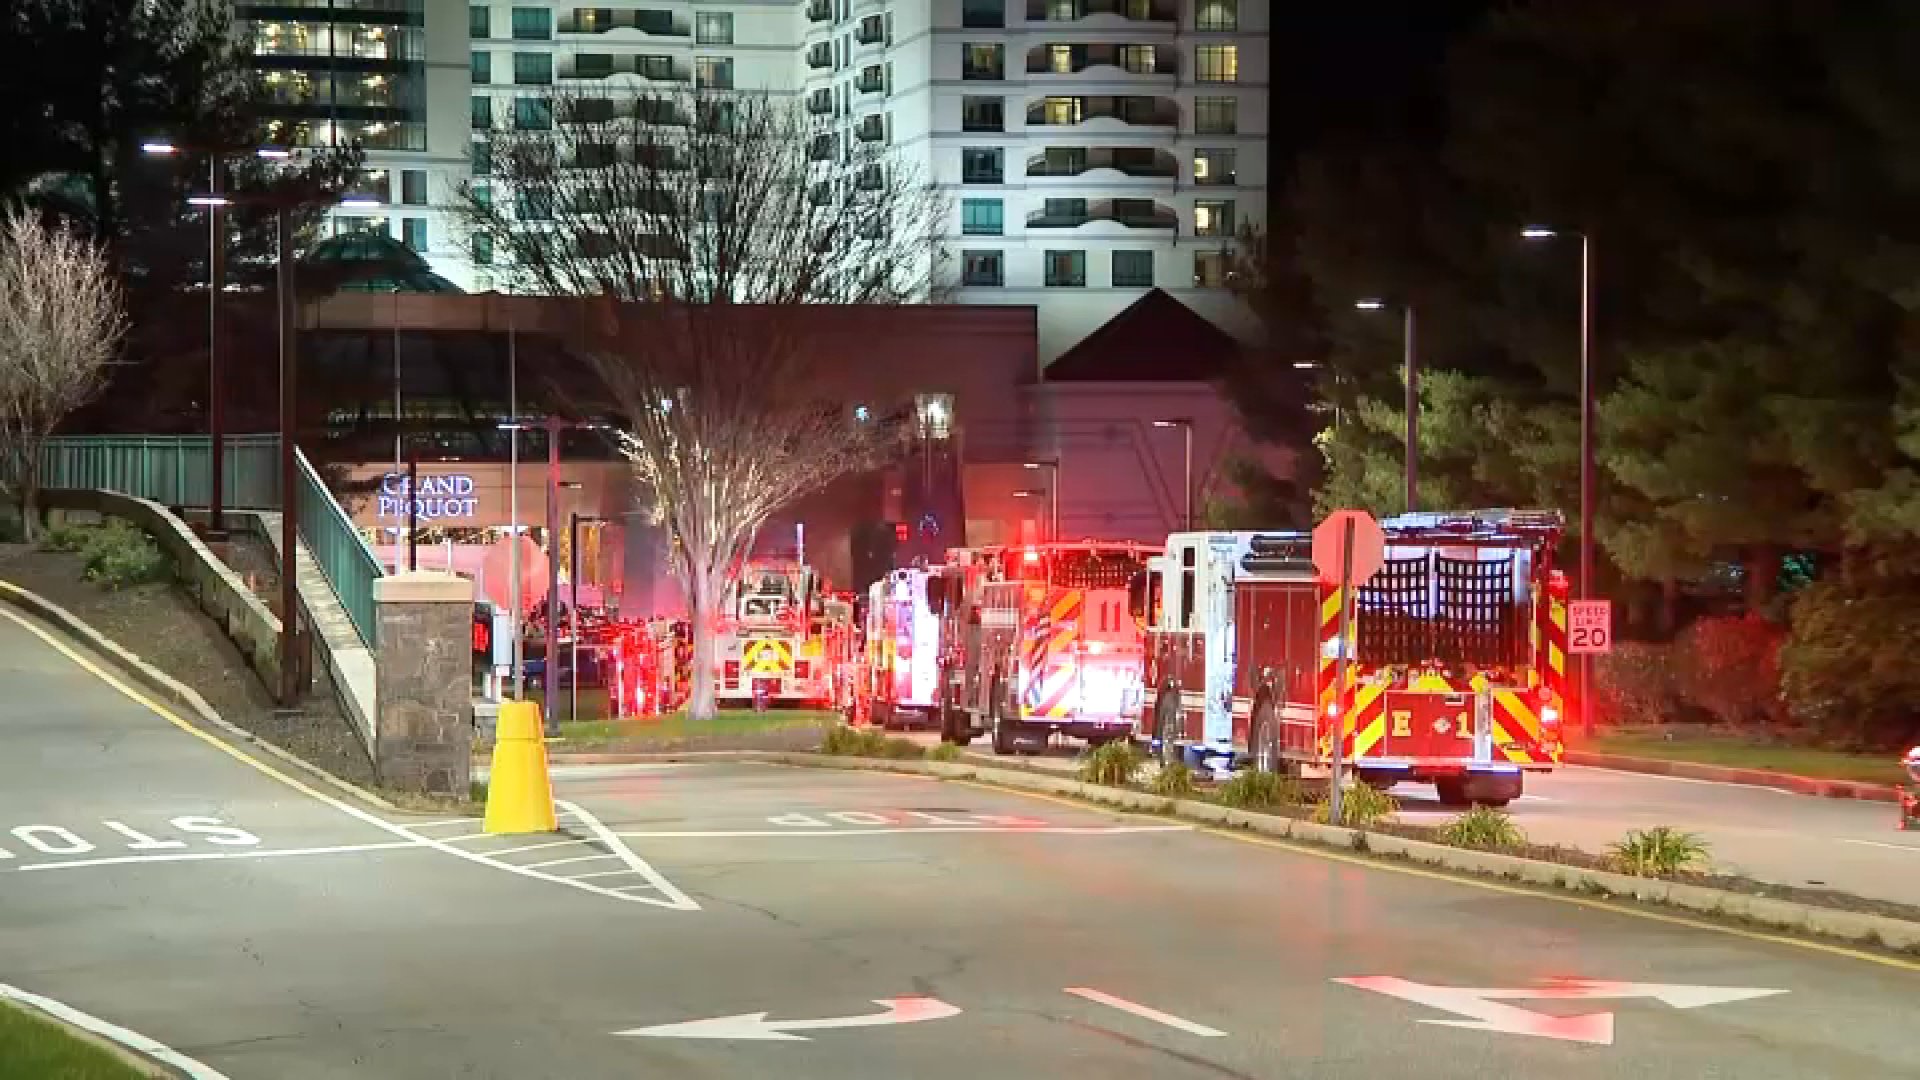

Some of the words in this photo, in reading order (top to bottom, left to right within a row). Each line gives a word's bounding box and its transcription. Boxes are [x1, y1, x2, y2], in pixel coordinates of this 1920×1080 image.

[1573, 627, 1606, 646] 20
[1391, 709, 1412, 737] E
[1455, 711, 1473, 738] 1
[0, 816, 262, 858] STO
